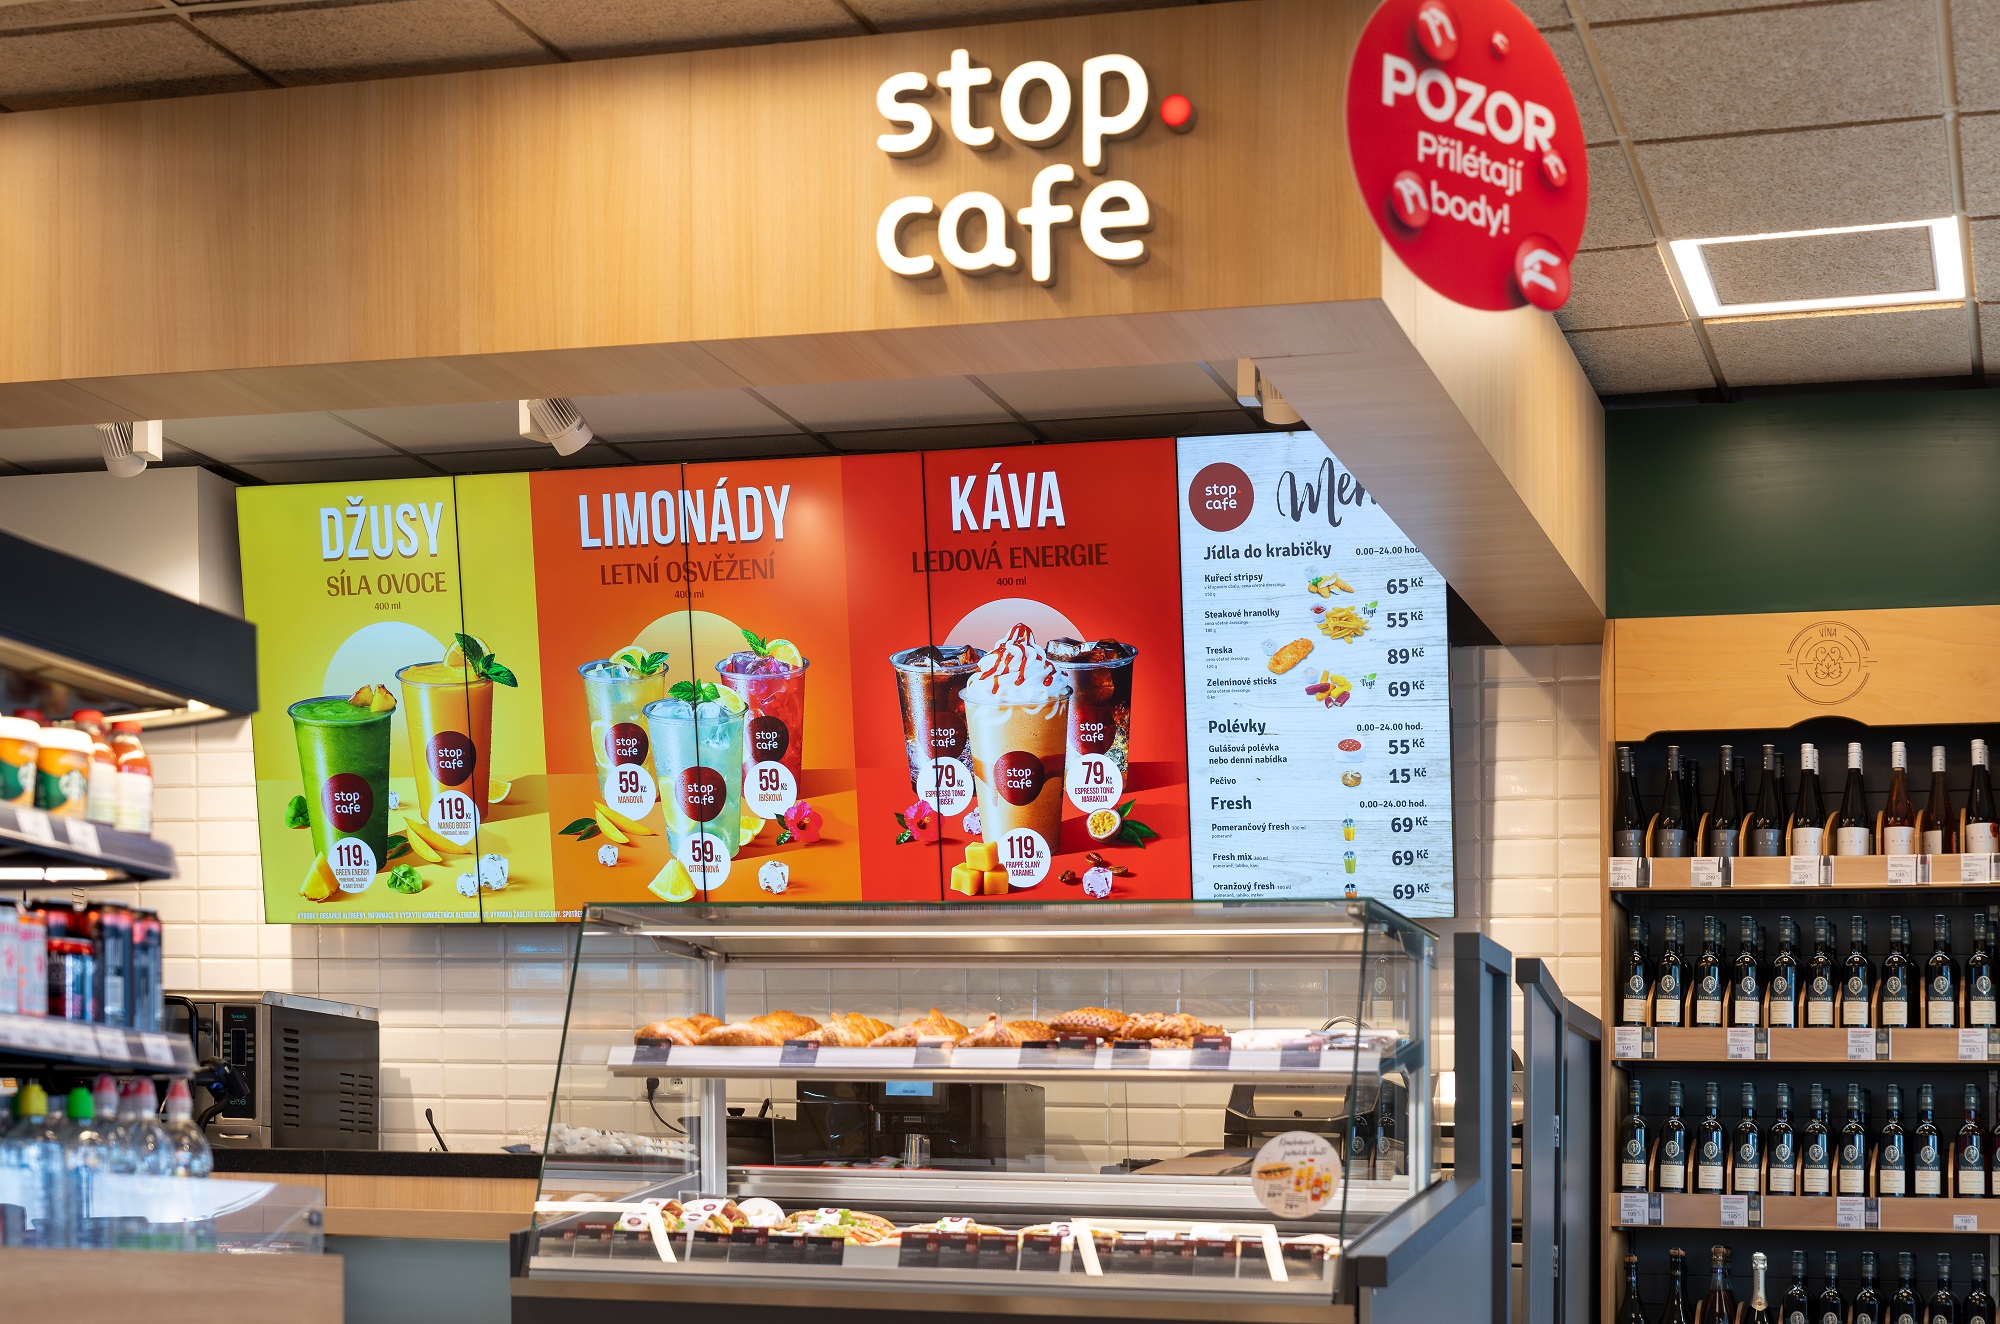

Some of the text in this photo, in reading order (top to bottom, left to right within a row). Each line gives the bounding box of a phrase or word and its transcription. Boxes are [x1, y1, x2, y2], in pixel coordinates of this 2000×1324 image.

[1381, 52, 1557, 153] POZOR
[1417, 130, 1524, 197] Přilétají
[1431, 179, 1510, 238] body!
[876, 164, 1150, 283] cafe
[950, 462, 1065, 532] KÁVA
[1205, 483, 1237, 499] stop
[1276, 457, 1378, 527] Me
[1205, 498, 1237, 511] cafe
[579, 477, 790, 549] LIMONÁDY
[320, 496, 443, 561] DŽUSY
[912, 541, 1108, 573] LEDOVÁ ENERGIE
[1204, 541, 1332, 560] Jídla do krabičky
[601, 551, 775, 585] LETNÍ OSVĚŽENÍ
[327, 569, 447, 596] SÍLA OVOCE
[996, 576, 1027, 586] 400 ml
[1204, 572, 1263, 582] Kuřecí stripsy
[1386, 577, 1423, 594] 65 Kč
[693, 590, 704, 598] ml
[374, 601, 401, 610] 400 ml
[1204, 608, 1280, 618] Steakové hranolky
[1387, 611, 1423, 628] 55 Kč
[1818, 626, 1836, 637] VÍNA
[1206, 646, 1232, 654] Treska
[1387, 647, 1424, 664] 89 Kč
[1207, 677, 1277, 686] Zeleninové sticks
[1388, 680, 1425, 697] 69 Kč
[1079, 722, 1103, 733] stop
[1208, 719, 1266, 735] Polévky
[1405, 722, 1423, 730] hod.
[616, 738, 637, 747] stop
[755, 731, 777, 741] stop
[1080, 732, 1104, 742] cafe
[438, 747, 462, 758] stop
[617, 747, 638, 756] cafe
[756, 741, 778, 750] cafe
[1208, 743, 1280, 753] Gulášová polévka
[1388, 738, 1425, 754] 55 Kč
[439, 757, 463, 769] cafe
[1209, 754, 1288, 764] nebo denní nabídka
[759, 768, 779, 791] 59
[932, 765, 955, 787] 79
[1006, 768, 1031, 779] stop
[1082, 761, 1104, 784] 79
[1389, 767, 1427, 783] 15 Kč
[619, 771, 639, 793] 59
[1007, 779, 1032, 789] cafe
[1210, 776, 1236, 785] Pečivo
[687, 783, 714, 795] stop
[1074, 787, 1100, 795] ESPRESSO
[334, 790, 360, 804] stop
[618, 794, 643, 803] MANGOVÁ
[1210, 795, 1252, 810] Fresh
[1408, 799, 1427, 807] hod.
[335, 802, 361, 814] cafe
[438, 797, 464, 819] 119
[1212, 822, 1267, 832] Pomerančový
[1268, 822, 1290, 830] fresh
[1390, 816, 1428, 832] 69 Kč
[692, 840, 713, 862] 59
[1008, 835, 1034, 858] 119
[337, 844, 362, 866] 119
[1392, 849, 1429, 865] 69 Kč
[1005, 860, 1040, 868] FRAPPÉ SLANÝ
[1213, 882, 1251, 891] Oranžový
[1393, 883, 1430, 899] 69 Kč
[368, 911, 394, 919] INFORMACE
